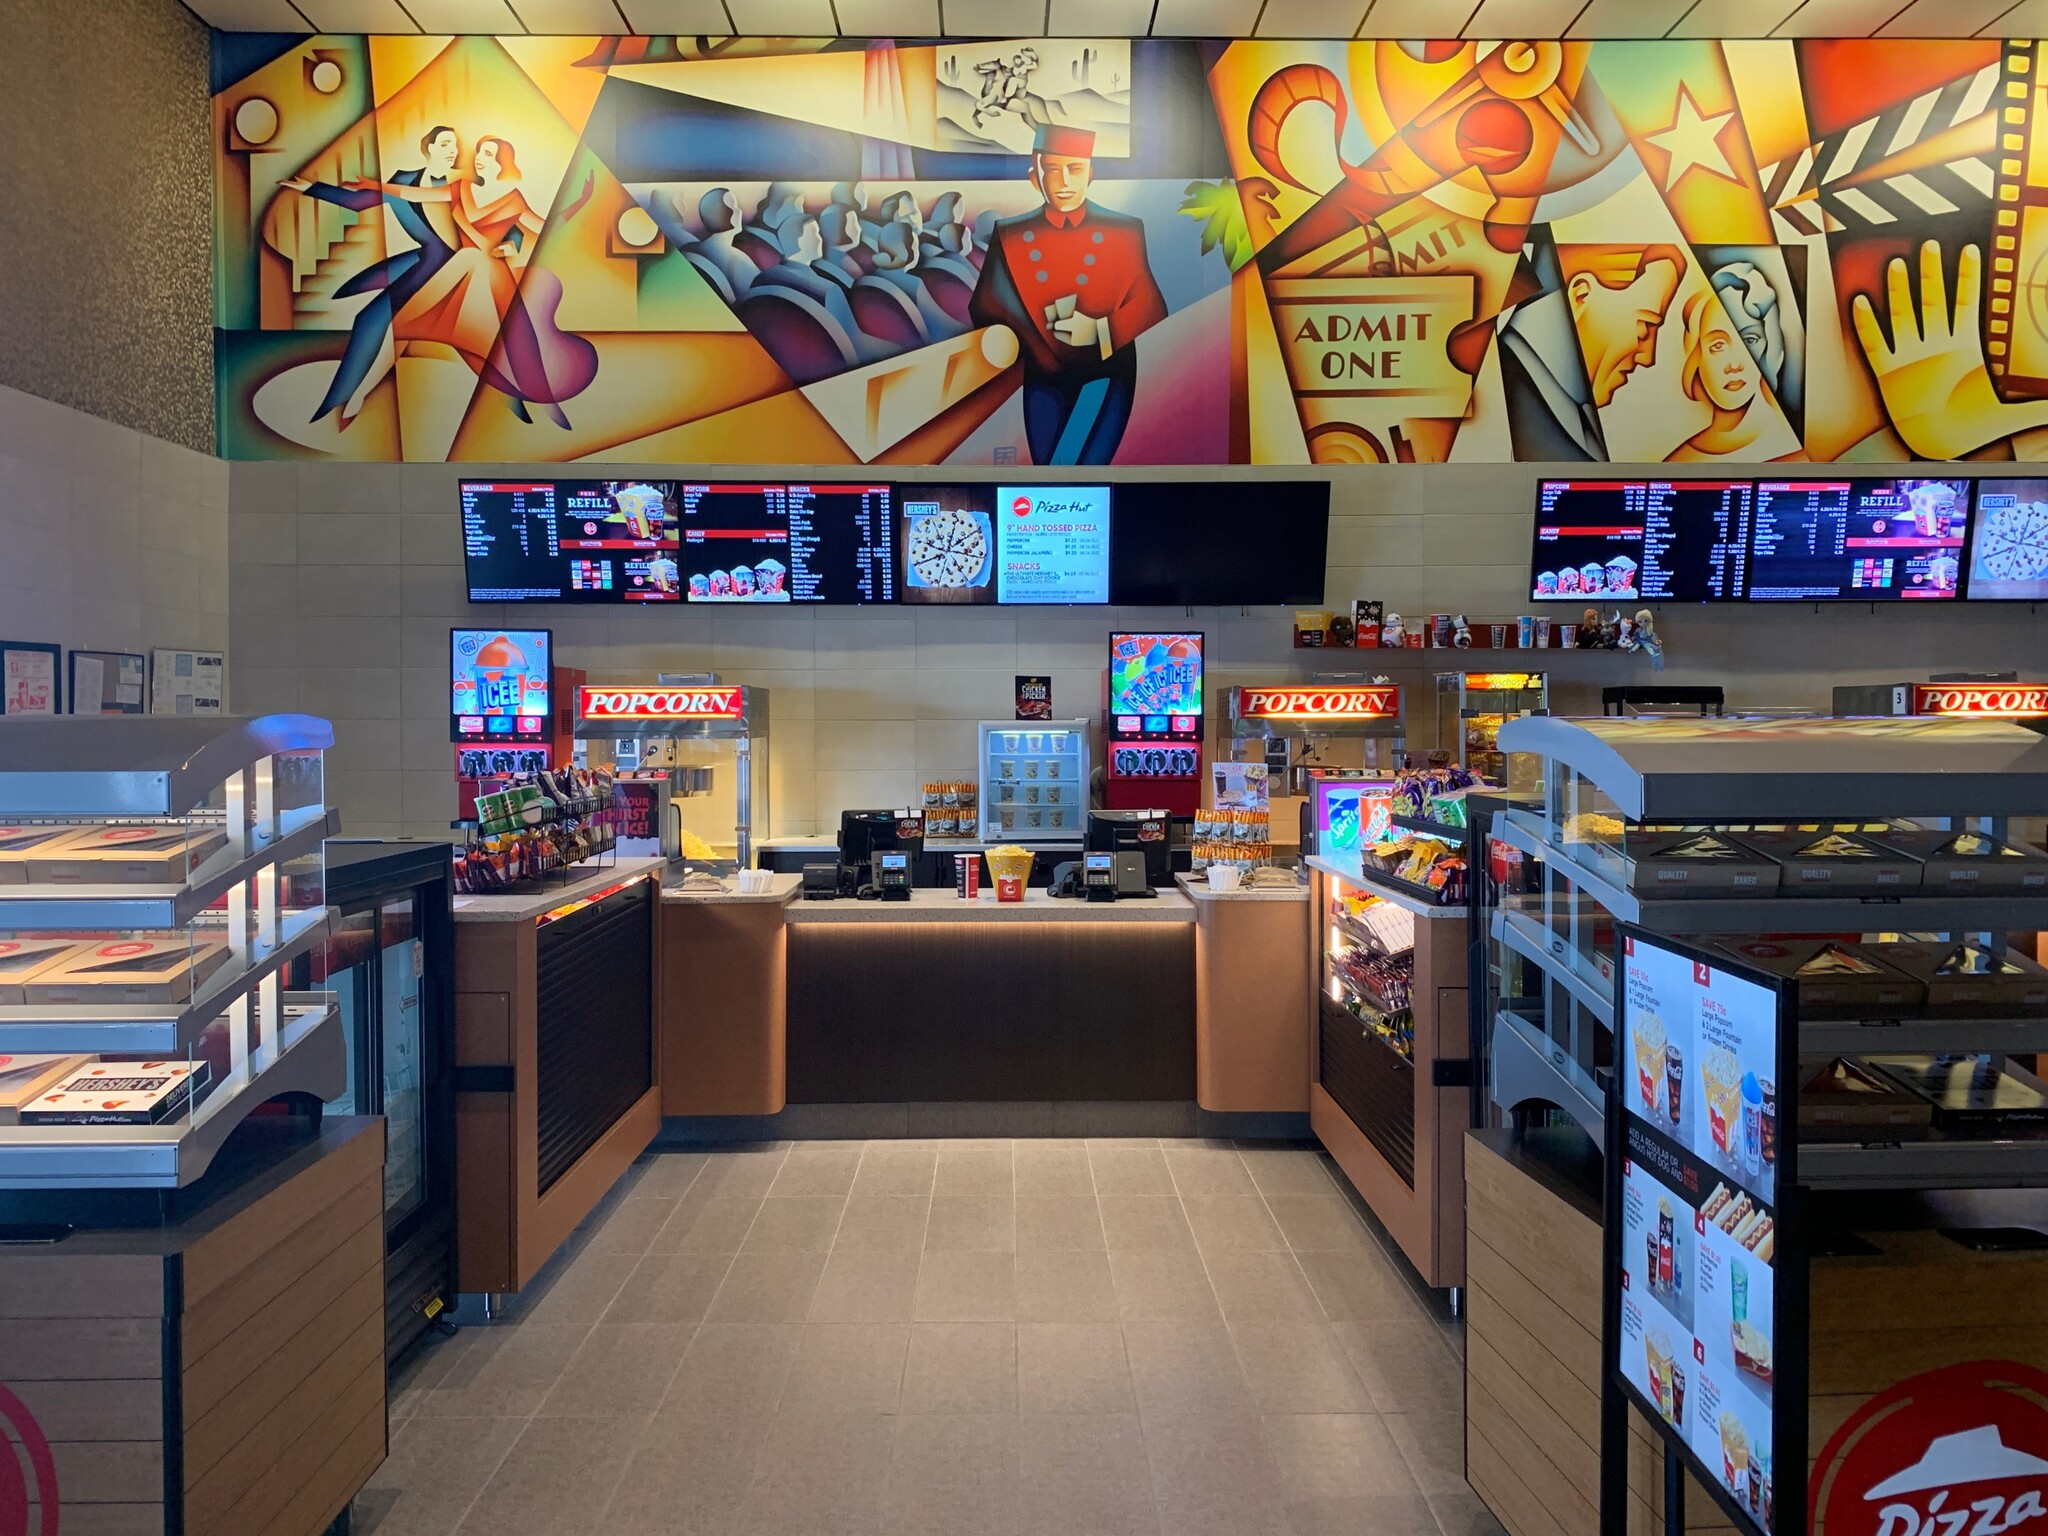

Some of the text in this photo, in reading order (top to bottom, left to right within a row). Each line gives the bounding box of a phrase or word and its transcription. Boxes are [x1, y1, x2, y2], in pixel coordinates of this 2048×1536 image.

[1294, 314, 1432, 343] ADMIT
[1321, 351, 1401, 380] ONE
[567, 498, 612, 508] REFILL
[1035, 501, 1094, 513] Pizza Hut
[1860, 496, 1904, 506] REFILL
[1983, 496, 2015, 508] HERSHEY'S
[906, 504, 938, 515] HERSHEY'S
[1358, 632, 1377, 640] Coca-Cola
[1122, 643, 1138, 657] ICEE
[1170, 666, 1193, 684] ICEE
[480, 680, 520, 708] ICEE
[1896, 692, 1902, 704] 3
[586, 694, 734, 713] POPCORN
[1246, 693, 1390, 713] POPCORN
[619, 796, 649, 806] YOUR
[624, 821, 649, 835] ICE!
[1330, 806, 1360, 840] Sprite
[1658, 870, 1688, 880] QUALITY
[1734, 876, 1757, 885] BAKED
[1802, 869, 1832, 879] QUALITY
[1877, 874, 1900, 883] BAKED
[1950, 870, 1979, 880] QUALITY
[2024, 876, 2046, 885] BAKED
[1625, 936, 1630, 951] 1
[1629, 966, 1640, 979] SAVE
[1699, 962, 1706, 981] 2
[1629, 976, 1654, 994] Large Popcorn
[1702, 996, 1727, 1017] SAVE 75¢
[1702, 1008, 1733, 1029] Large Popcorn
[1710, 1022, 1722, 1036] Large
[1723, 1029, 1742, 1044] Fountain
[1708, 1034, 1722, 1047] Frozen
[72, 1078, 163, 1091] HERSHEY'S
[1628, 1127, 1638, 1142] ADD
[1645, 1137, 1669, 1160] REGULAR
[1669, 1154, 1679, 1166] OR
[1628, 1136, 1683, 1182] ANGUS HOT DOG AND
[1626, 1162, 1629, 1173] 3
[1683, 1164, 1698, 1182] SAVE
[1698, 1218, 1703, 1232] 4
[1697, 1346, 1702, 1359] 6
